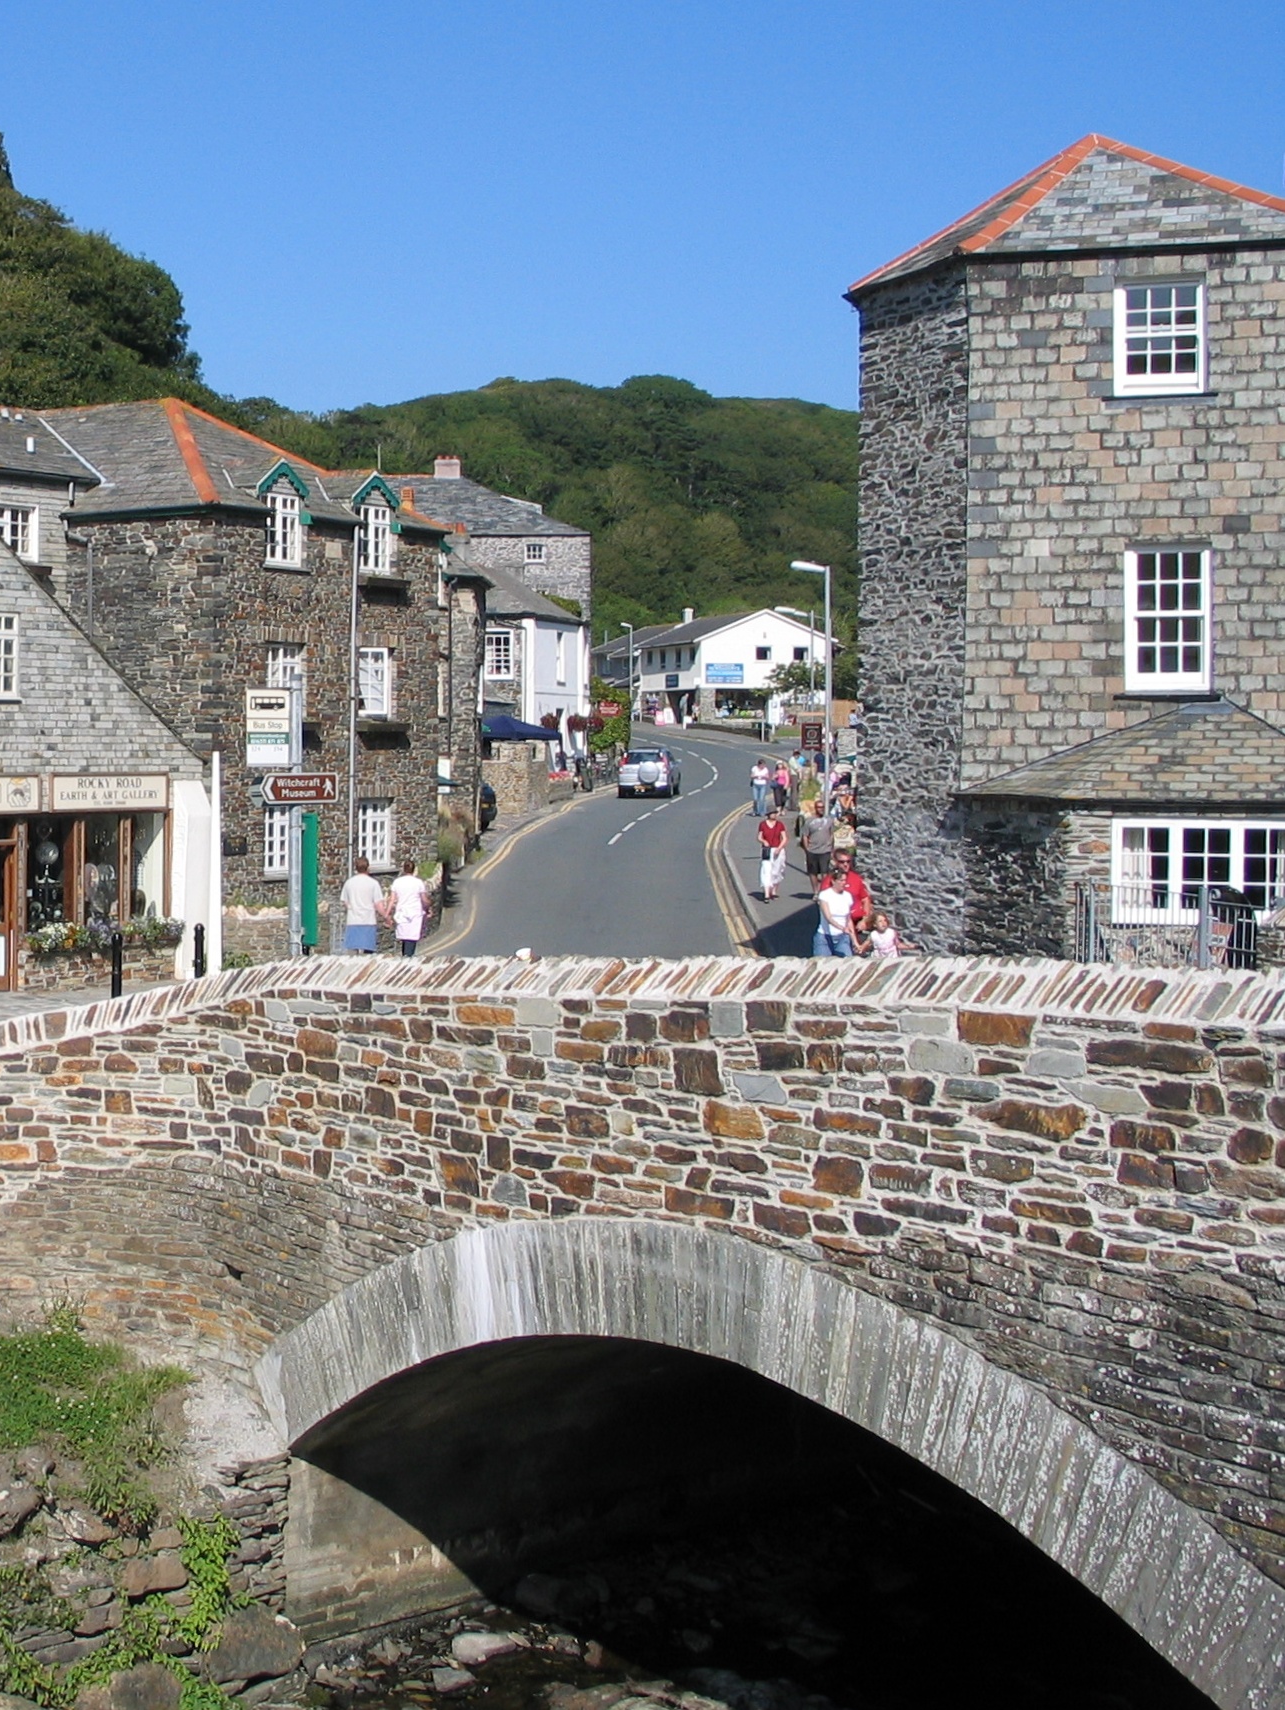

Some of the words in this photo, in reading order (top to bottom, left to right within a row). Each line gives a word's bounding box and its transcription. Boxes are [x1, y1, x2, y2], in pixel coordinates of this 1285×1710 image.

[253, 721, 265, 729] Bus
[267, 721, 283, 730] Stop
[77, 777, 111, 789] ROCKY
[116, 777, 143, 788] ROAD
[276, 778, 321, 787] Witchcraft
[59, 791, 88, 801] EARTH
[91, 790, 98, 800] &
[101, 789, 119, 800] ART
[121, 788, 159, 799] GALLERY
[281, 788, 317, 797] Museum
